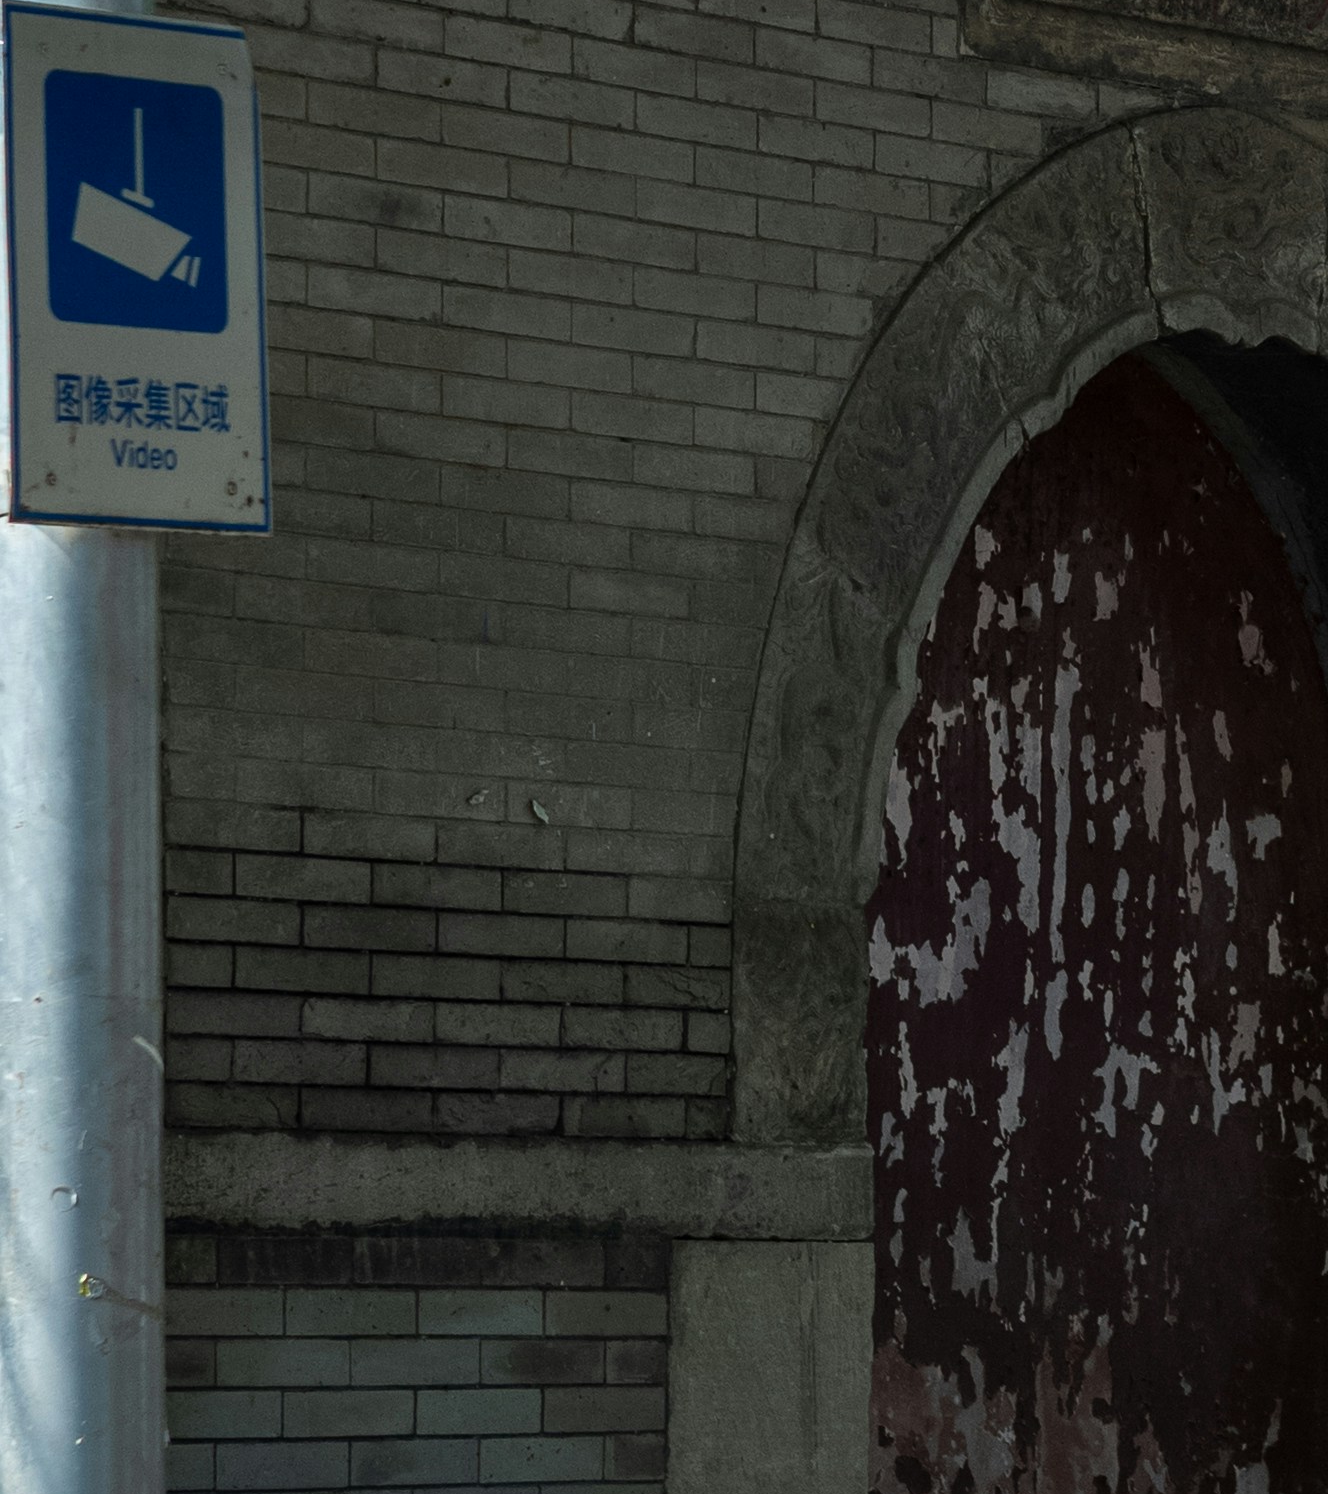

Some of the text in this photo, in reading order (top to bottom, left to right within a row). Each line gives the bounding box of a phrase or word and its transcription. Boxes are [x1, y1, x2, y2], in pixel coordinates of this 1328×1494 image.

[54, 372, 231, 433] 图像采集区域
[109, 437, 178, 472] Video
